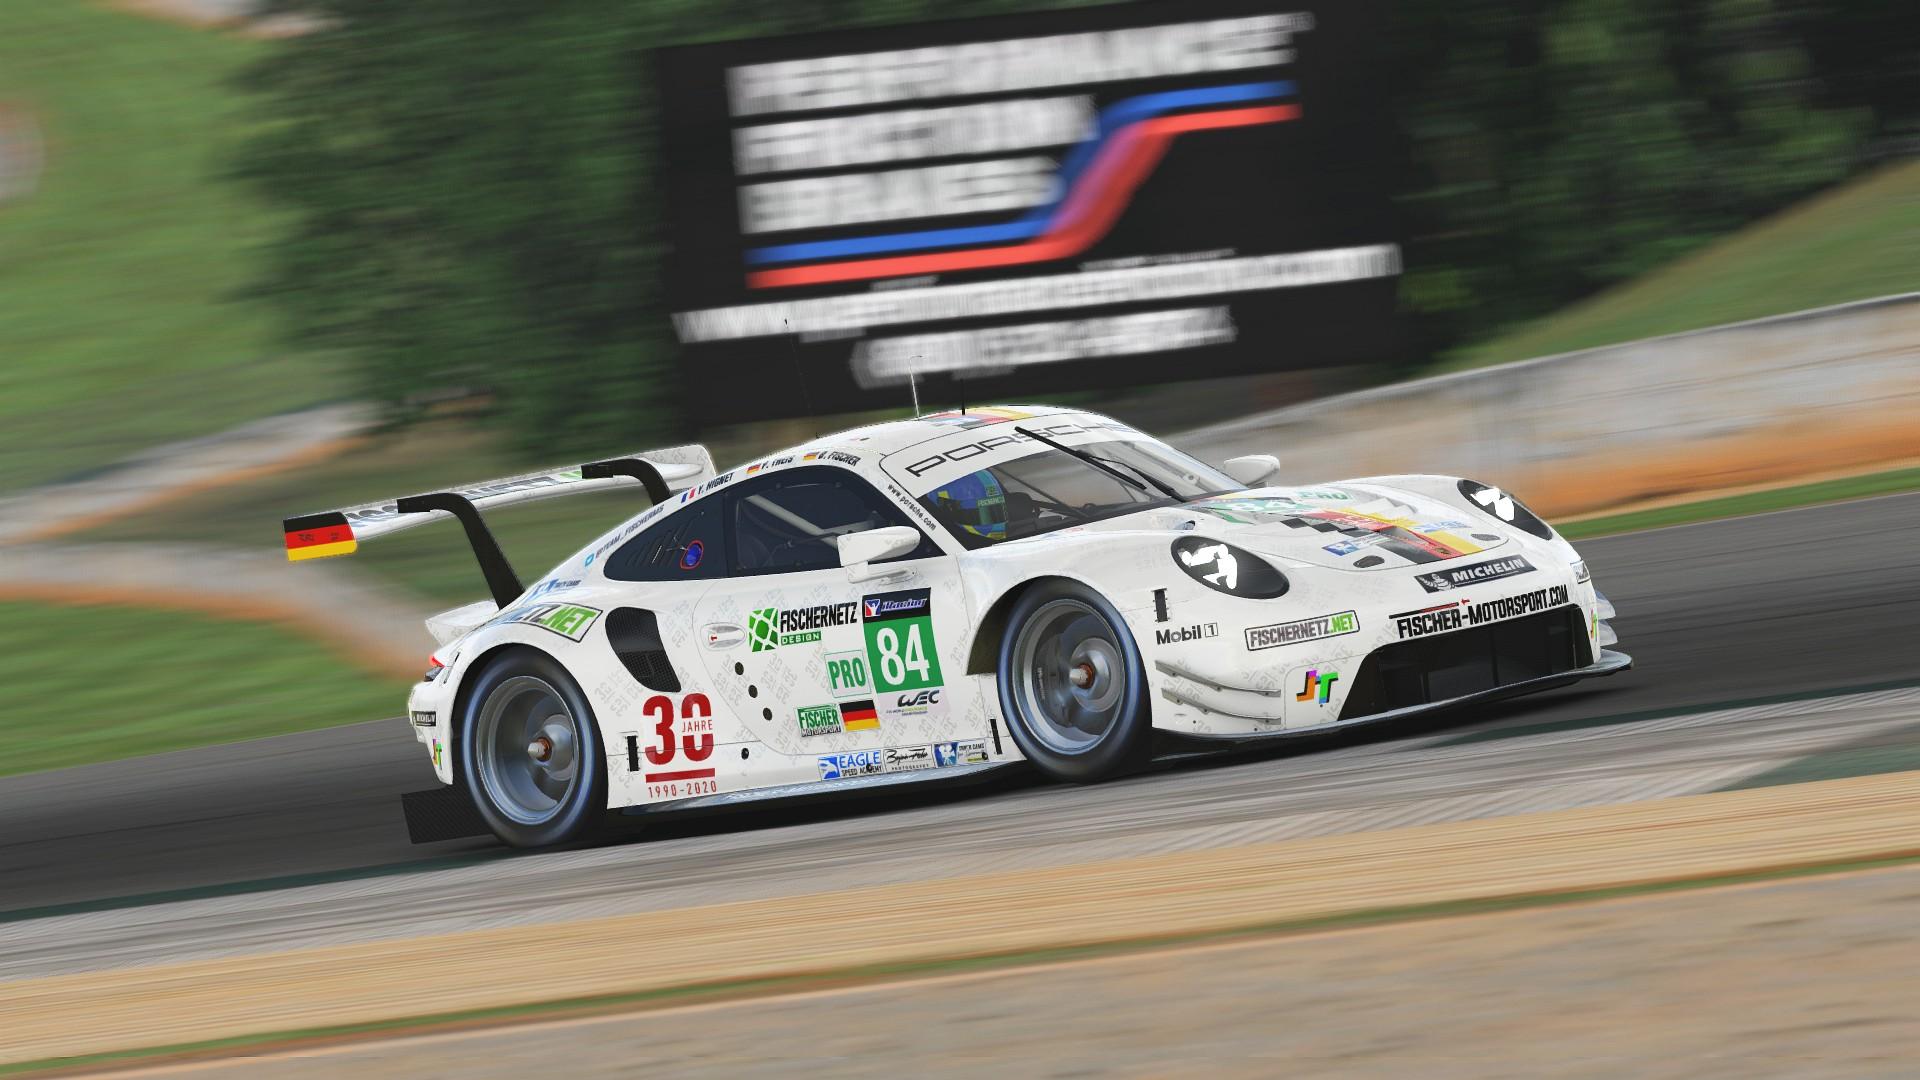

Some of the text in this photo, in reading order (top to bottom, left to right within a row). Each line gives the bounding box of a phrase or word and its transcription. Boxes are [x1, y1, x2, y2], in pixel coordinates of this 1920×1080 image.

[905, 422, 1135, 478] PORSCHE
[1451, 558, 1525, 584] MICHELIN
[780, 602, 857, 633] FISCHERNETZ
[1396, 584, 1570, 639] FISCHER-MOTORSPORT.COM
[782, 633, 820, 645] DESIGN
[1156, 625, 1202, 645] Mobil
[1250, 614, 1354, 647] FISCHERNETZ.NET
[877, 624, 930, 685] 84
[828, 657, 867, 690] PRO
[898, 690, 940, 707] WEC
[643, 693, 714, 765] 30
[682, 719, 713, 733] JAHRE
[797, 708, 840, 729] FISCHER
[840, 751, 881, 768] EAGLE
[841, 769, 857, 777] SPEED
[648, 780, 717, 798] 1990-2020
